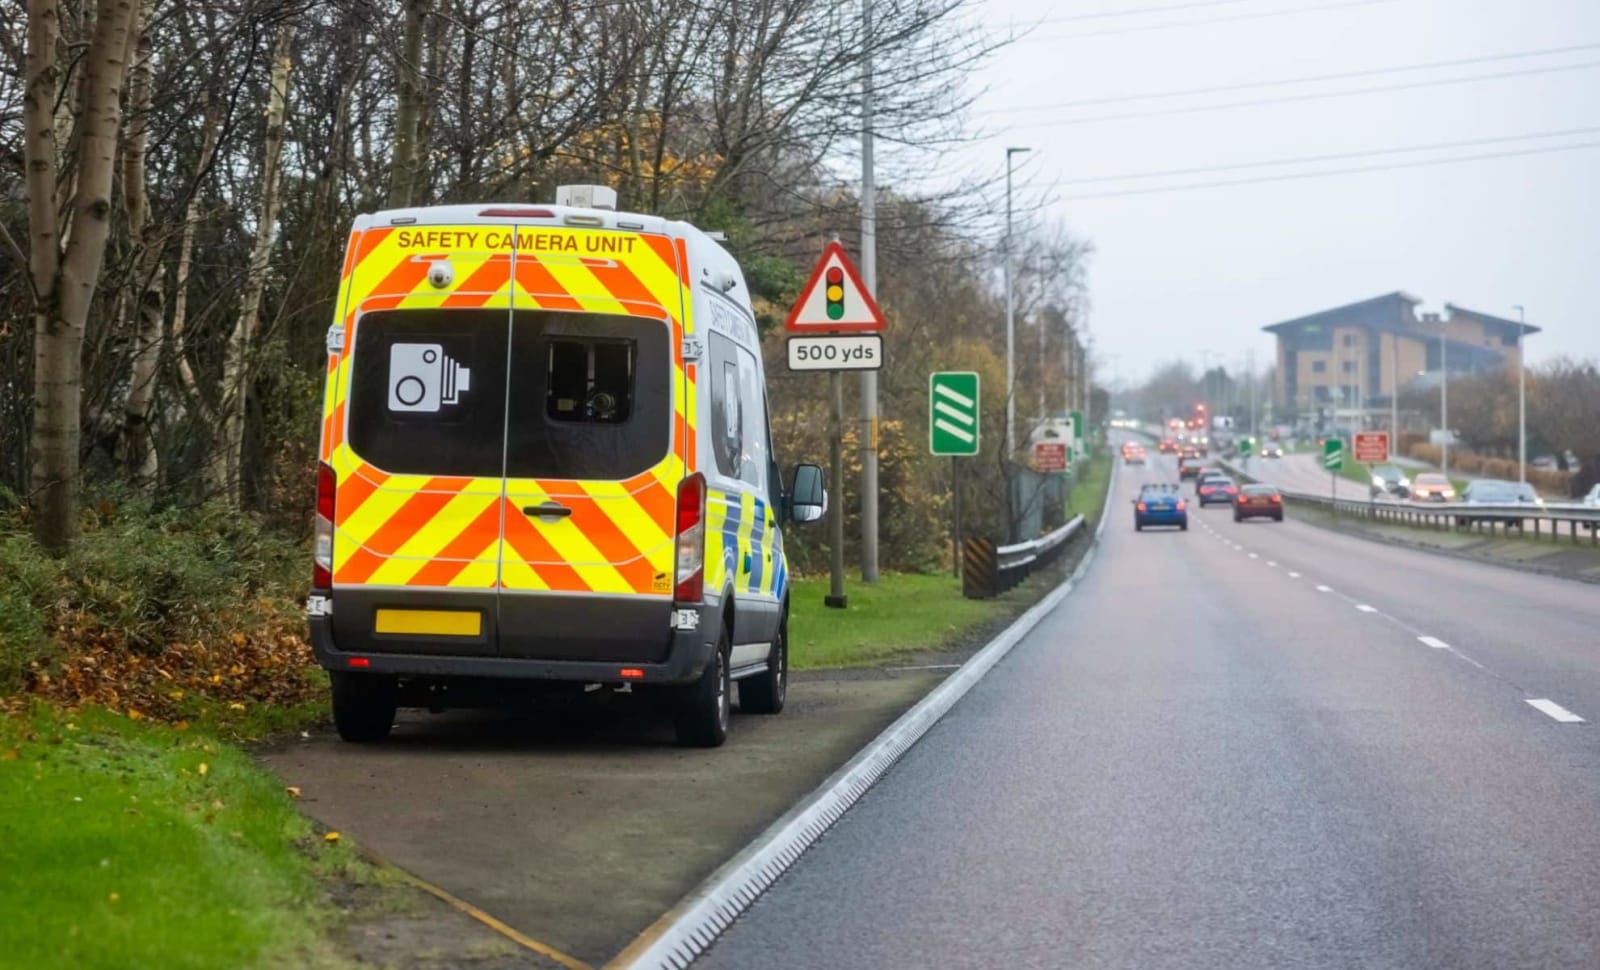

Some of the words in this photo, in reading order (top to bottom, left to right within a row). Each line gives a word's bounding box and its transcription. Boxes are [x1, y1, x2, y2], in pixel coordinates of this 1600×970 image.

[397, 231, 479, 249] SAFETY
[485, 232, 579, 251] CAMERA
[585, 235, 637, 254] UNIT
[797, 345, 837, 361] 500
[841, 344, 874, 362] yds
